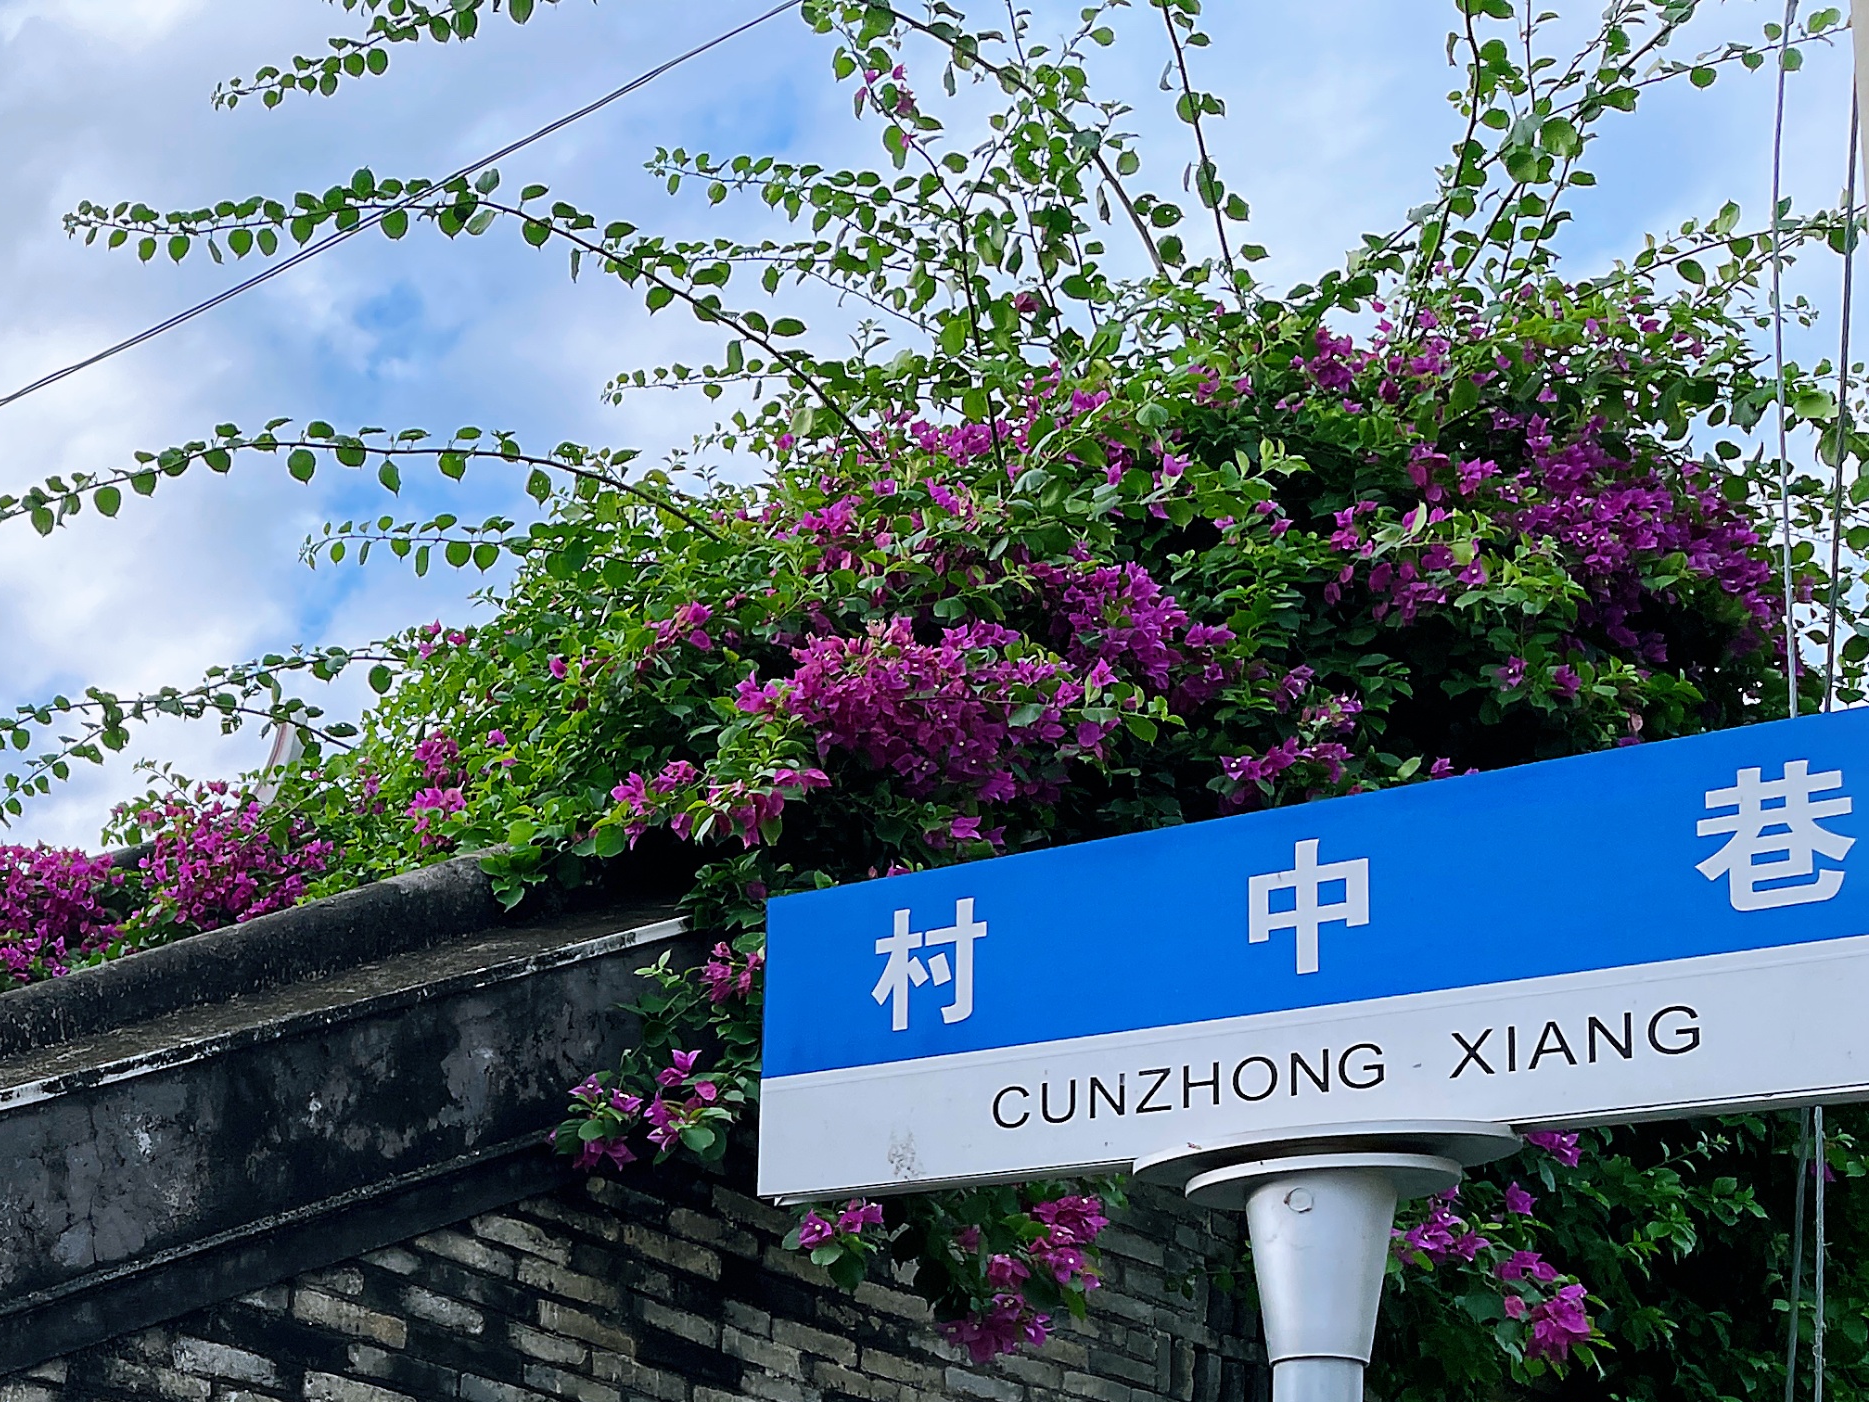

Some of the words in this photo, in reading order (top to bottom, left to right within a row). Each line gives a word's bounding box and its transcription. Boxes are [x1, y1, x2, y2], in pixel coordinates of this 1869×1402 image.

[871, 759, 1857, 1033] 村中巷
[991, 1042, 1386, 1130] CUNZHONG
[1448, 1004, 1702, 1080] XIANG
